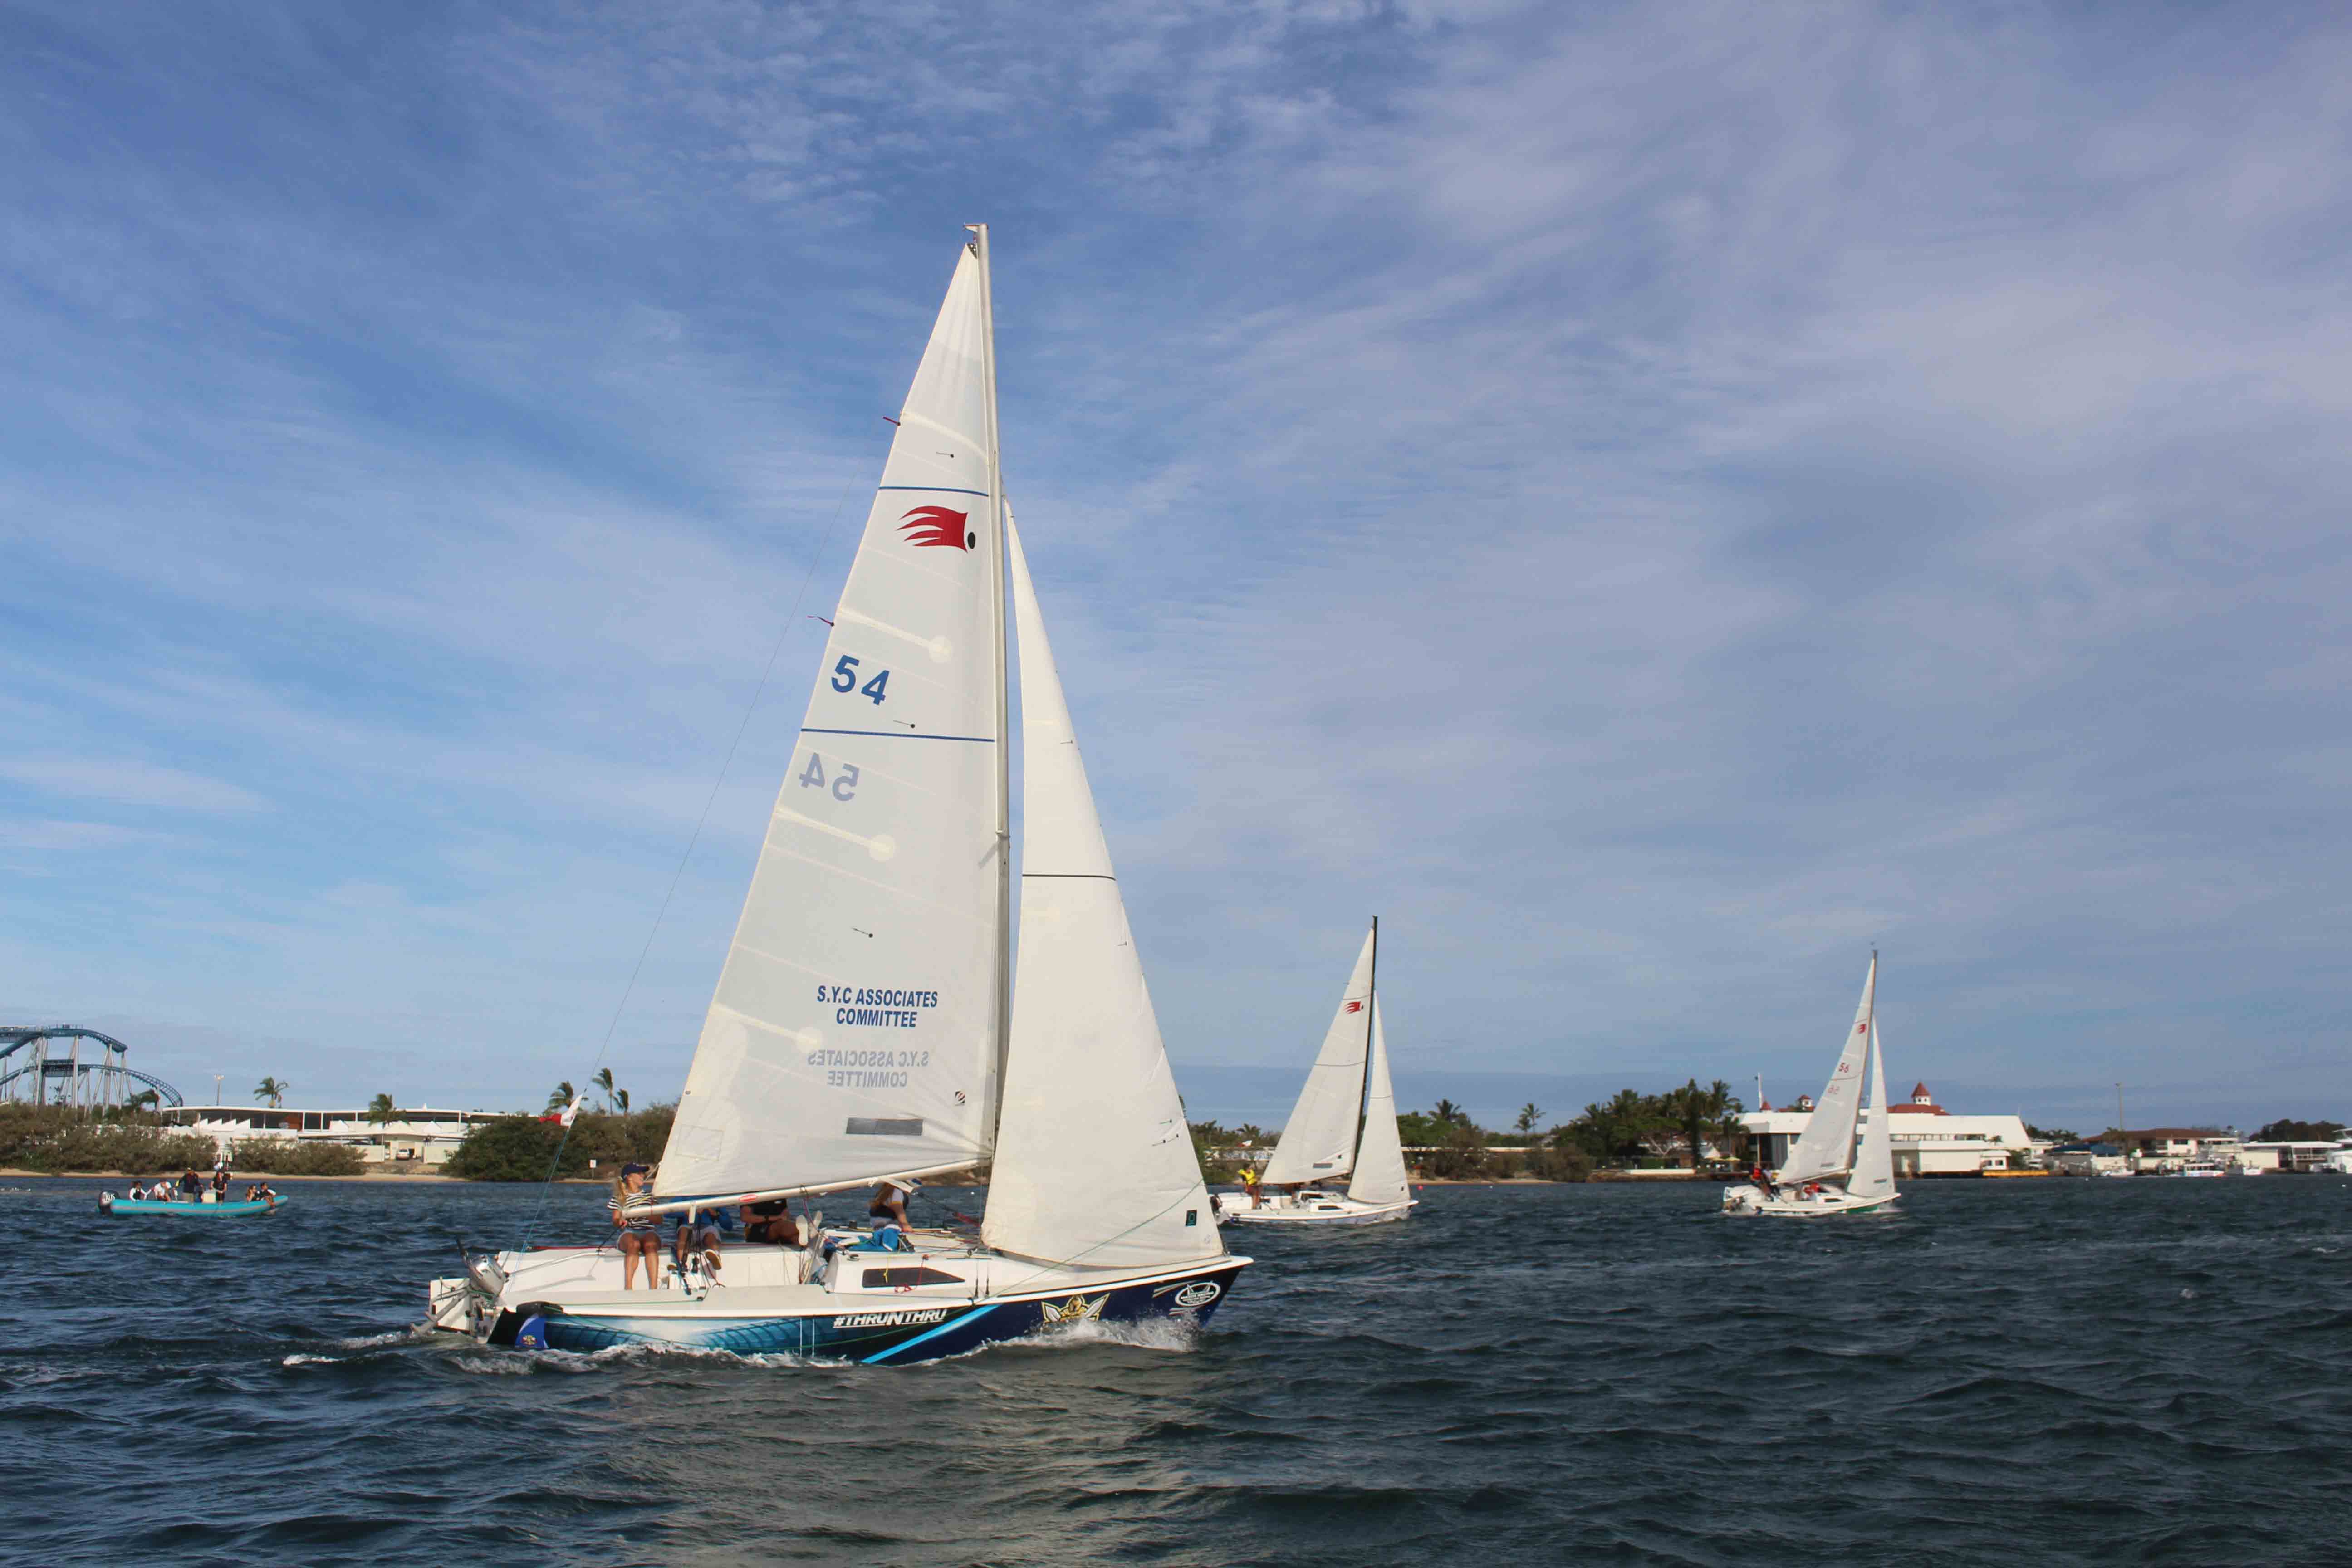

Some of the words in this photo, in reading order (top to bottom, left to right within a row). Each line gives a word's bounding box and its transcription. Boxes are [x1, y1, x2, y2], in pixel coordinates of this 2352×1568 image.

[831, 654, 890, 705] 54
[817, 985, 853, 1004] S.Y.C
[855, 988, 938, 1008] ASSOCIATES
[836, 1008, 918, 1028] COMMITTEE
